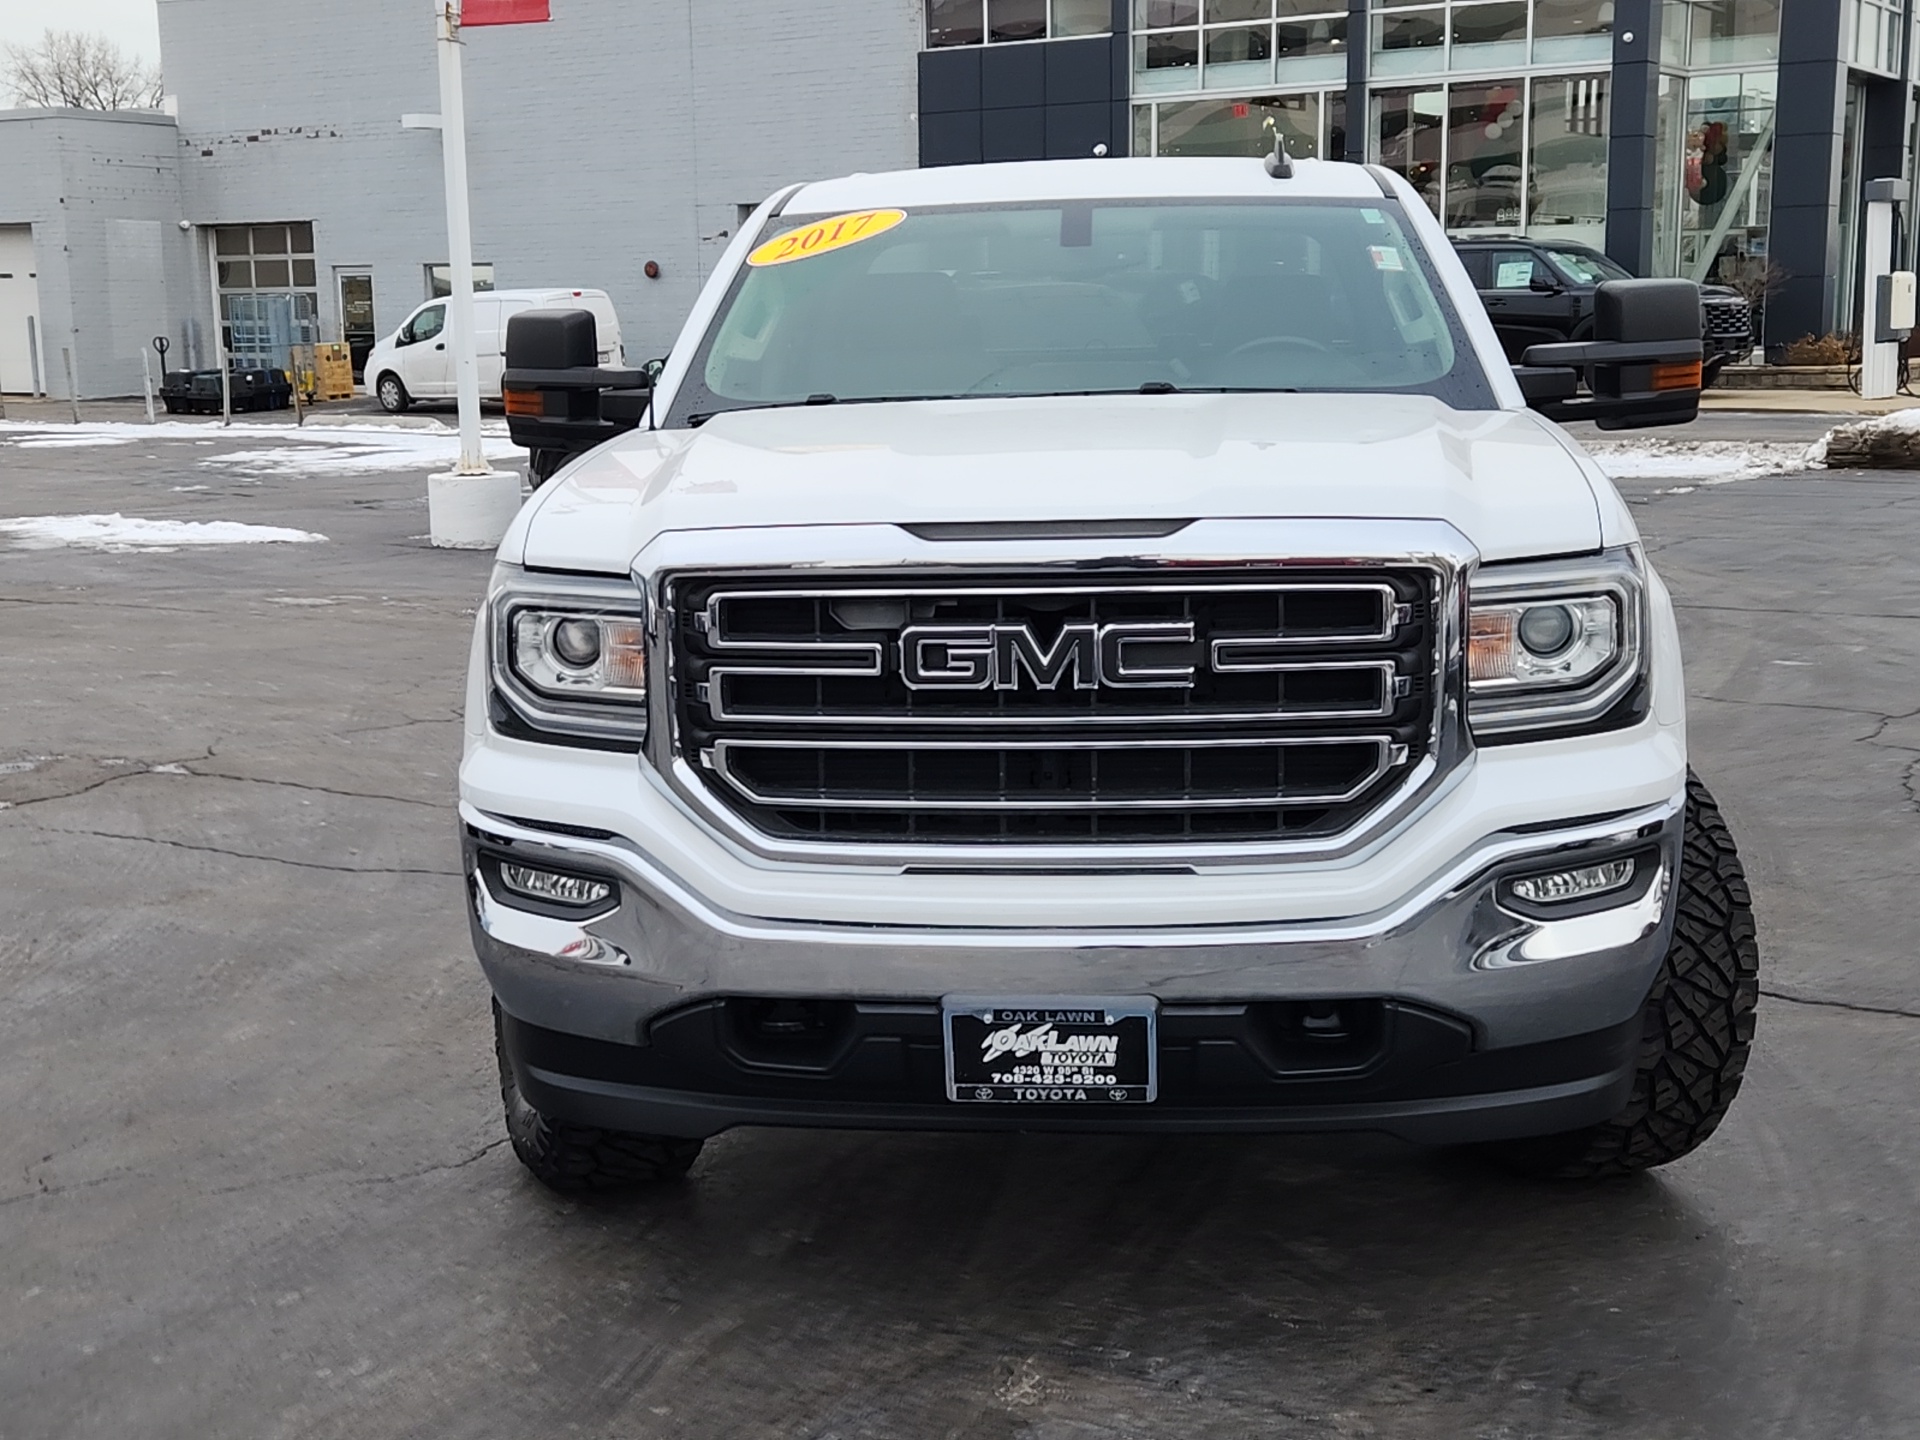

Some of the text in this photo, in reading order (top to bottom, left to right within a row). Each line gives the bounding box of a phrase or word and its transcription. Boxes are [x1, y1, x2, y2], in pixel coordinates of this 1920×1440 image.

[774, 213, 877, 259] 2017
[899, 624, 1195, 690] GMC
[1001, 1011, 1096, 1022] OAK LAWN
[1050, 1052, 1108, 1064] TOYOTA
[1012, 1066, 1040, 1075] 4320
[991, 1073, 1117, 1084] 708-423-5200
[1013, 1088, 1088, 1100] TOYOTA
